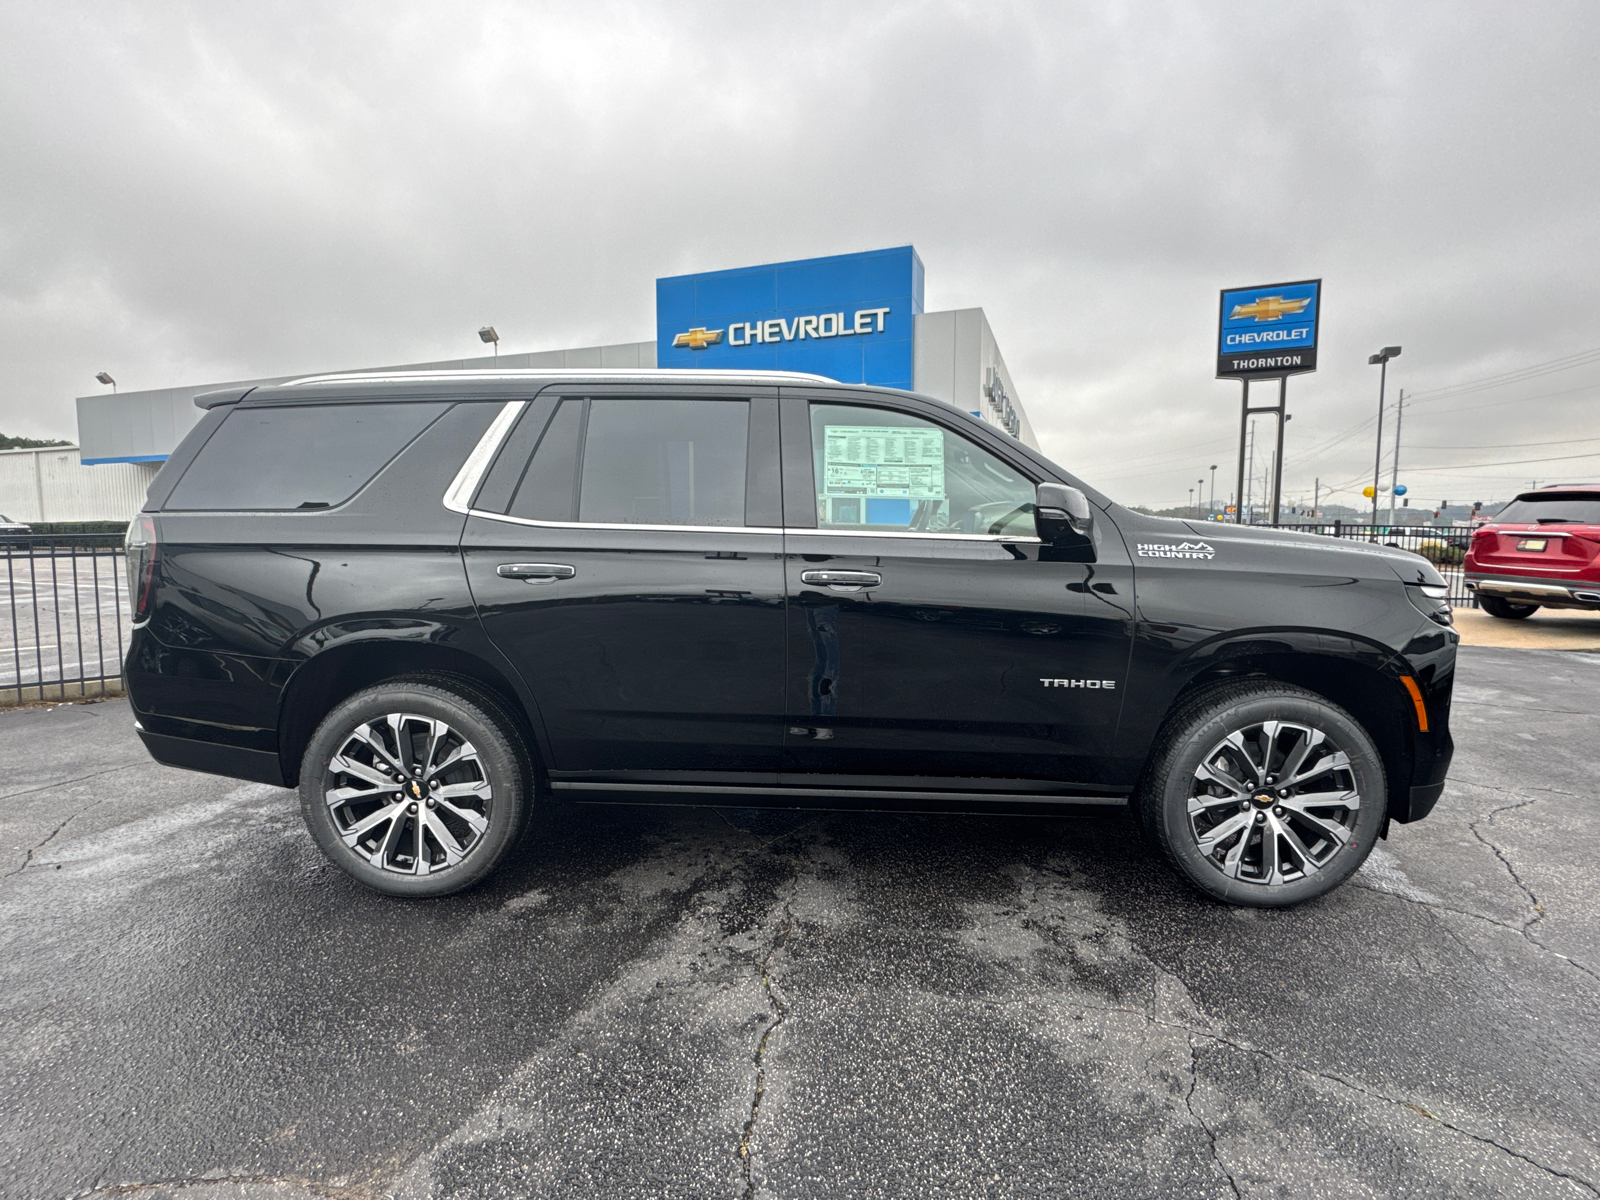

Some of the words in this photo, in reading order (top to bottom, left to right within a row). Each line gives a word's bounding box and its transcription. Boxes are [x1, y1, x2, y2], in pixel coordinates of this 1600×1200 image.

[728, 307, 890, 347] CHEVROLET
[1226, 328, 1310, 345] CHEVROLET
[1232, 355, 1301, 370] THORNTON
[1137, 543, 1177, 551] HIGH
[1137, 550, 1216, 560] COUNTRY
[1040, 678, 1116, 690] TAHOE
